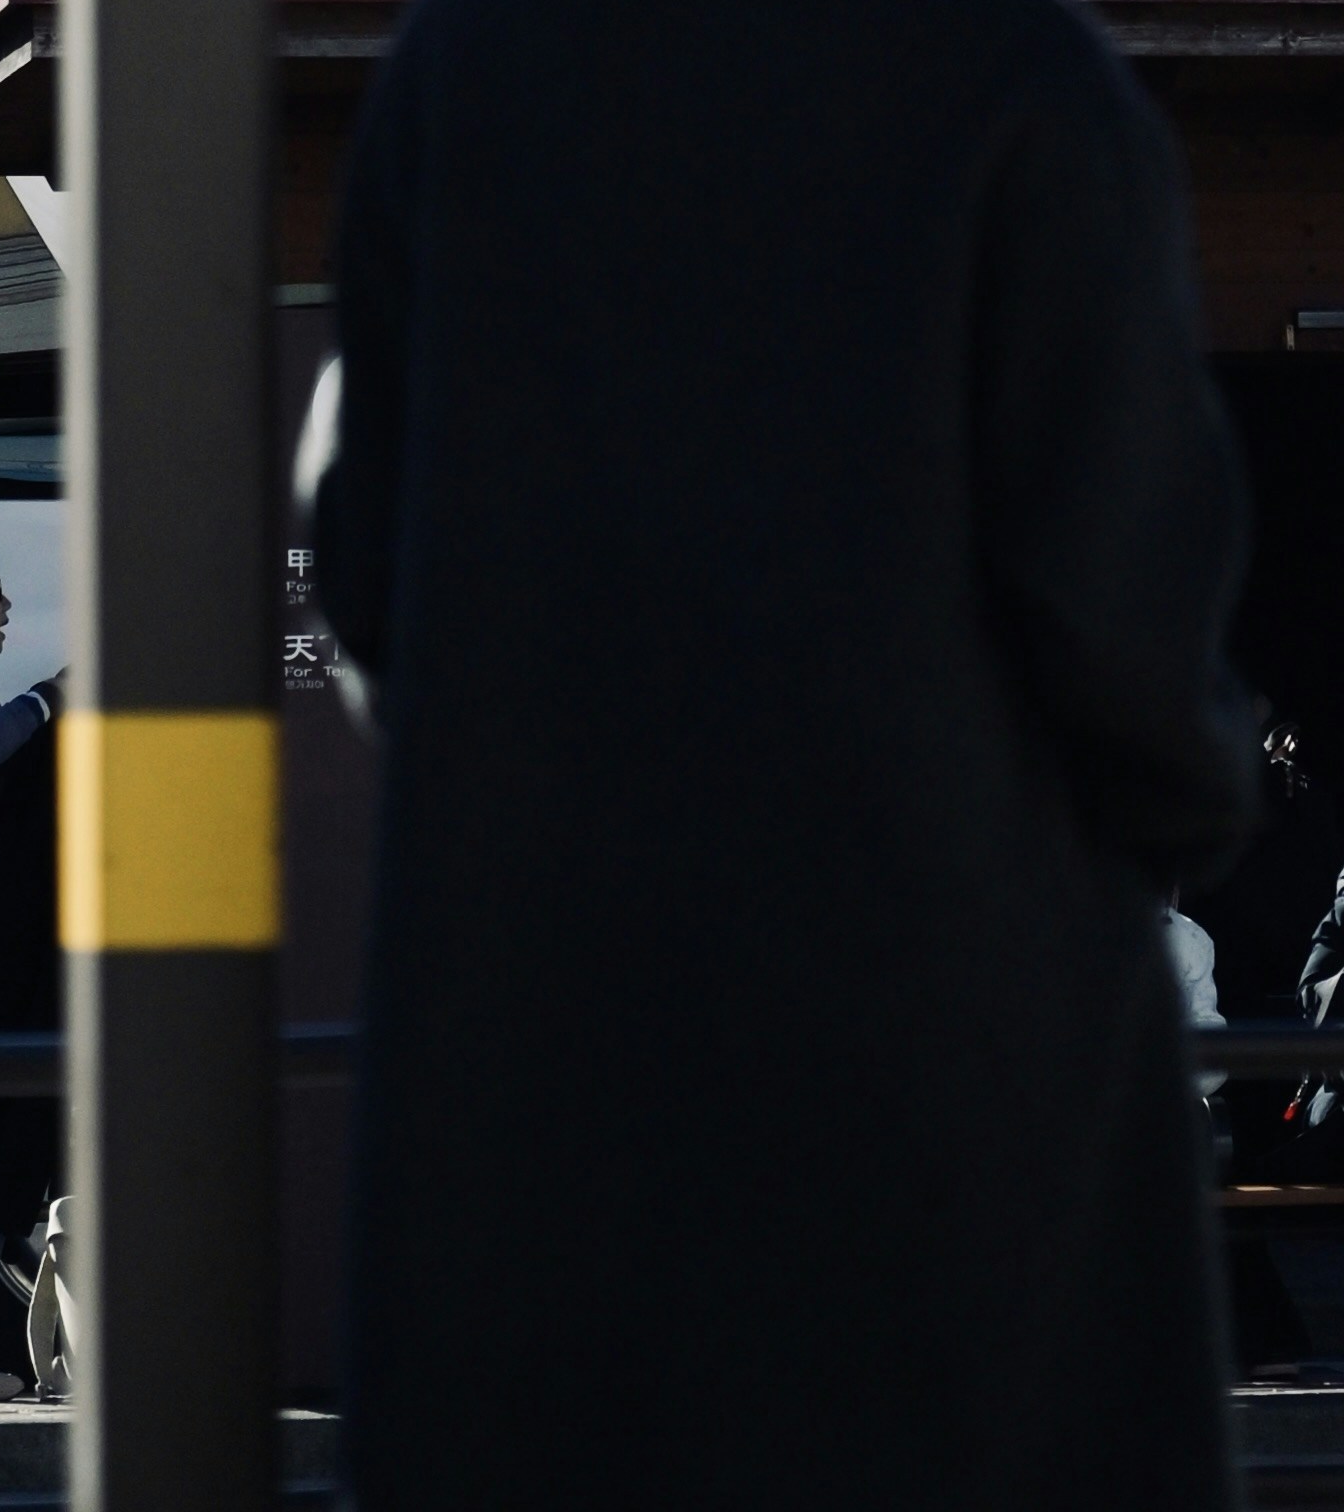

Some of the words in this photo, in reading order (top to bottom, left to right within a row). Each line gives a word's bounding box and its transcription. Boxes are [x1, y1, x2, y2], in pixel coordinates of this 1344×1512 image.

[287, 549, 314, 577] 甲
[286, 581, 315, 593] For
[284, 666, 313, 678] For
